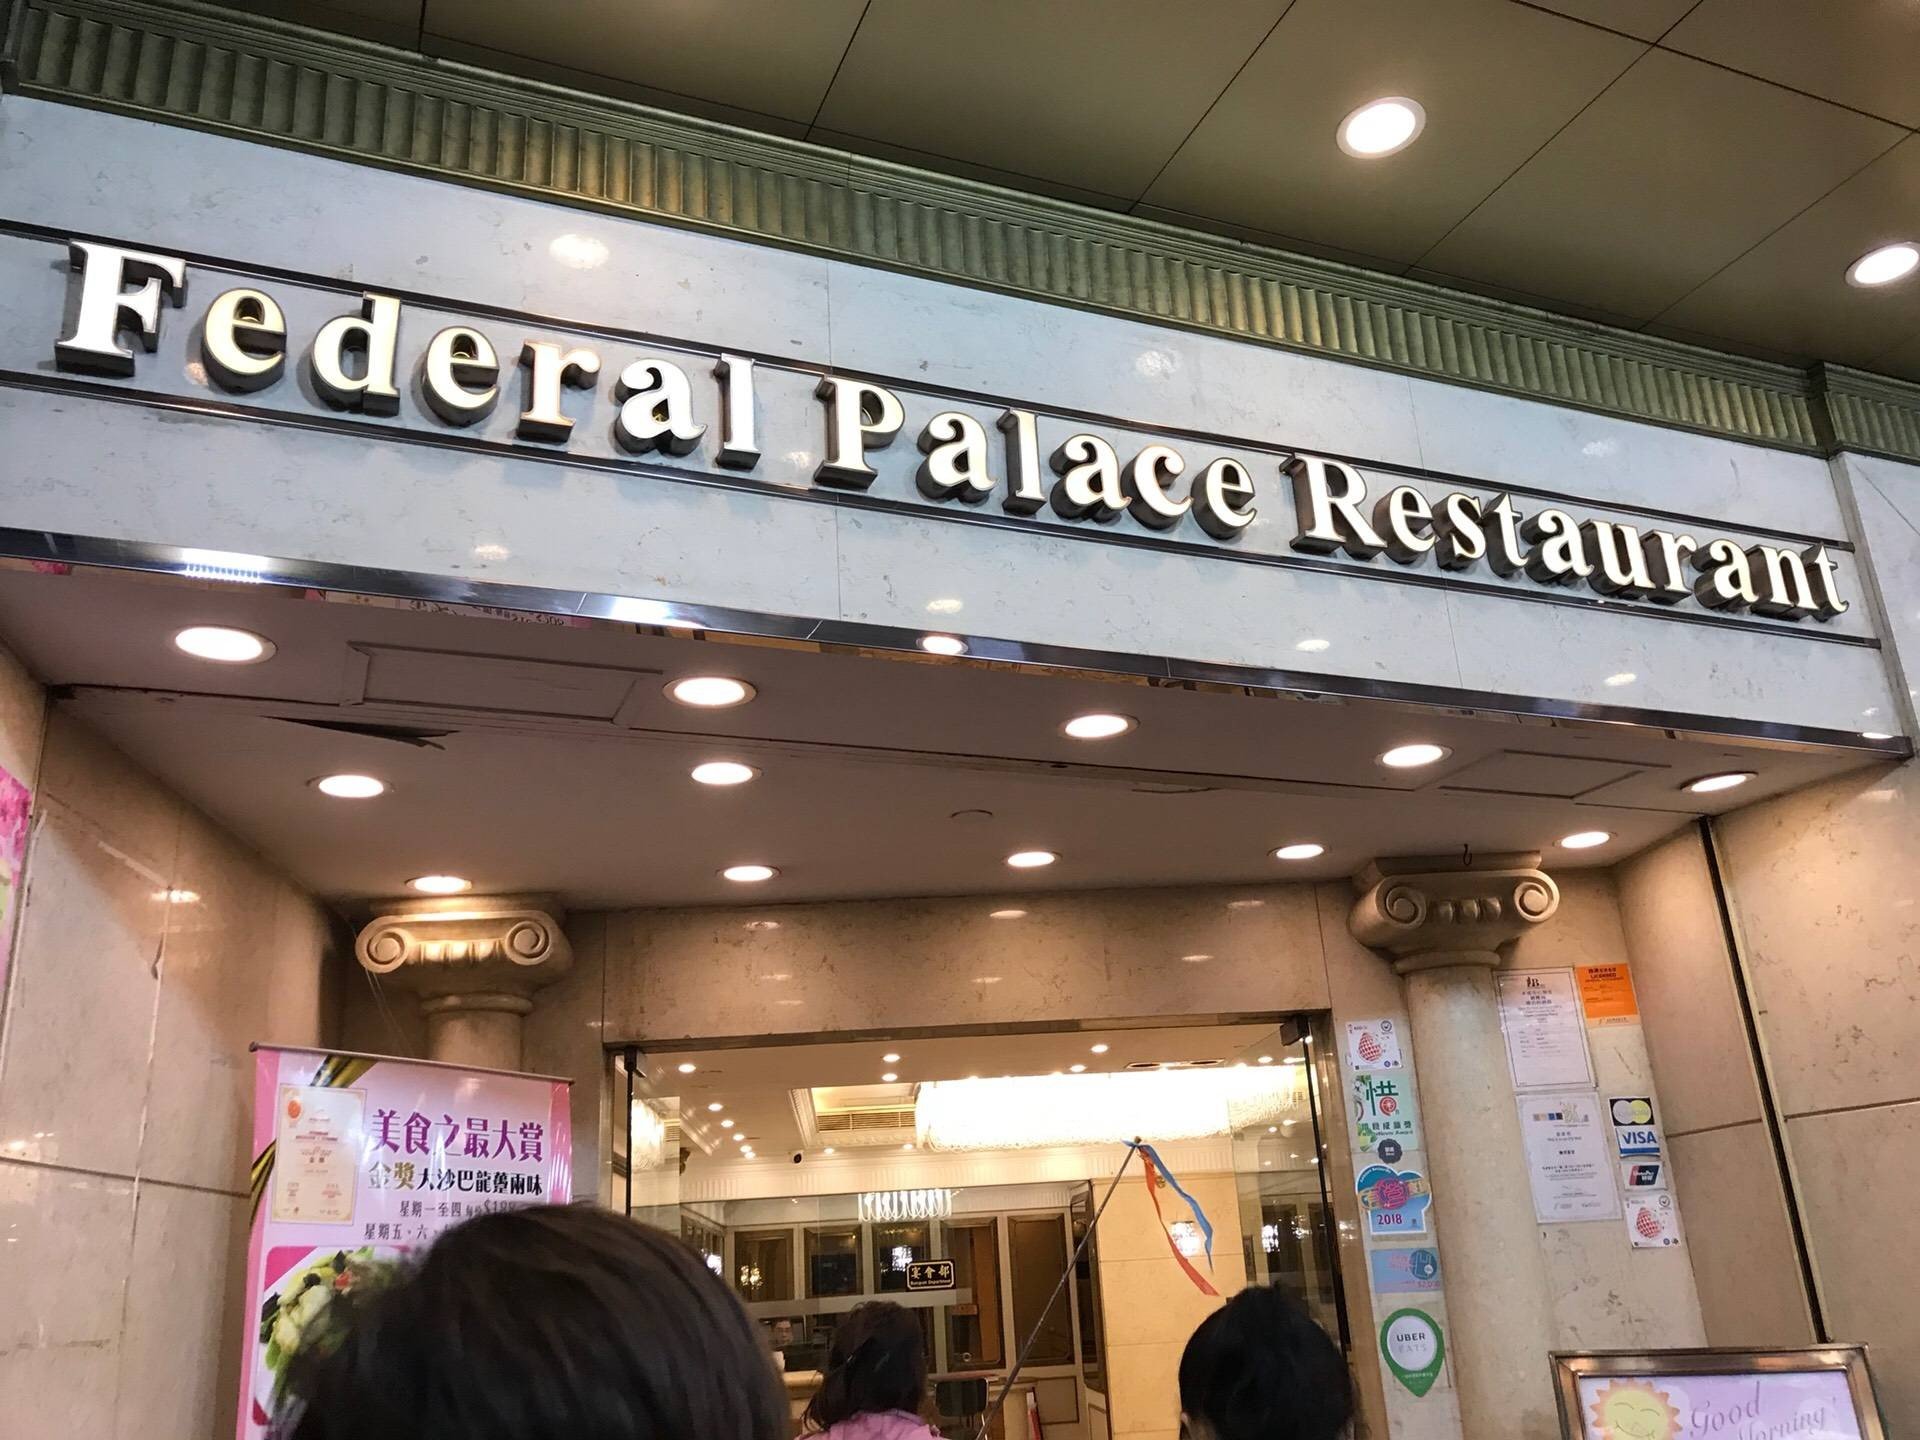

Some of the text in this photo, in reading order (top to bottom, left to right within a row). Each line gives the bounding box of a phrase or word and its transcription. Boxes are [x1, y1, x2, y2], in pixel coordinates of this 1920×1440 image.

[55, 239, 1849, 622] Federal Palace Restaurant
[372, 1108, 544, 1163] 美食之最大賞
[1622, 1131, 1657, 1144] VISA
[1377, 1213, 1402, 1225] 2018
[1396, 1332, 1425, 1342] UBER
[1690, 1380, 1761, 1437] Good
